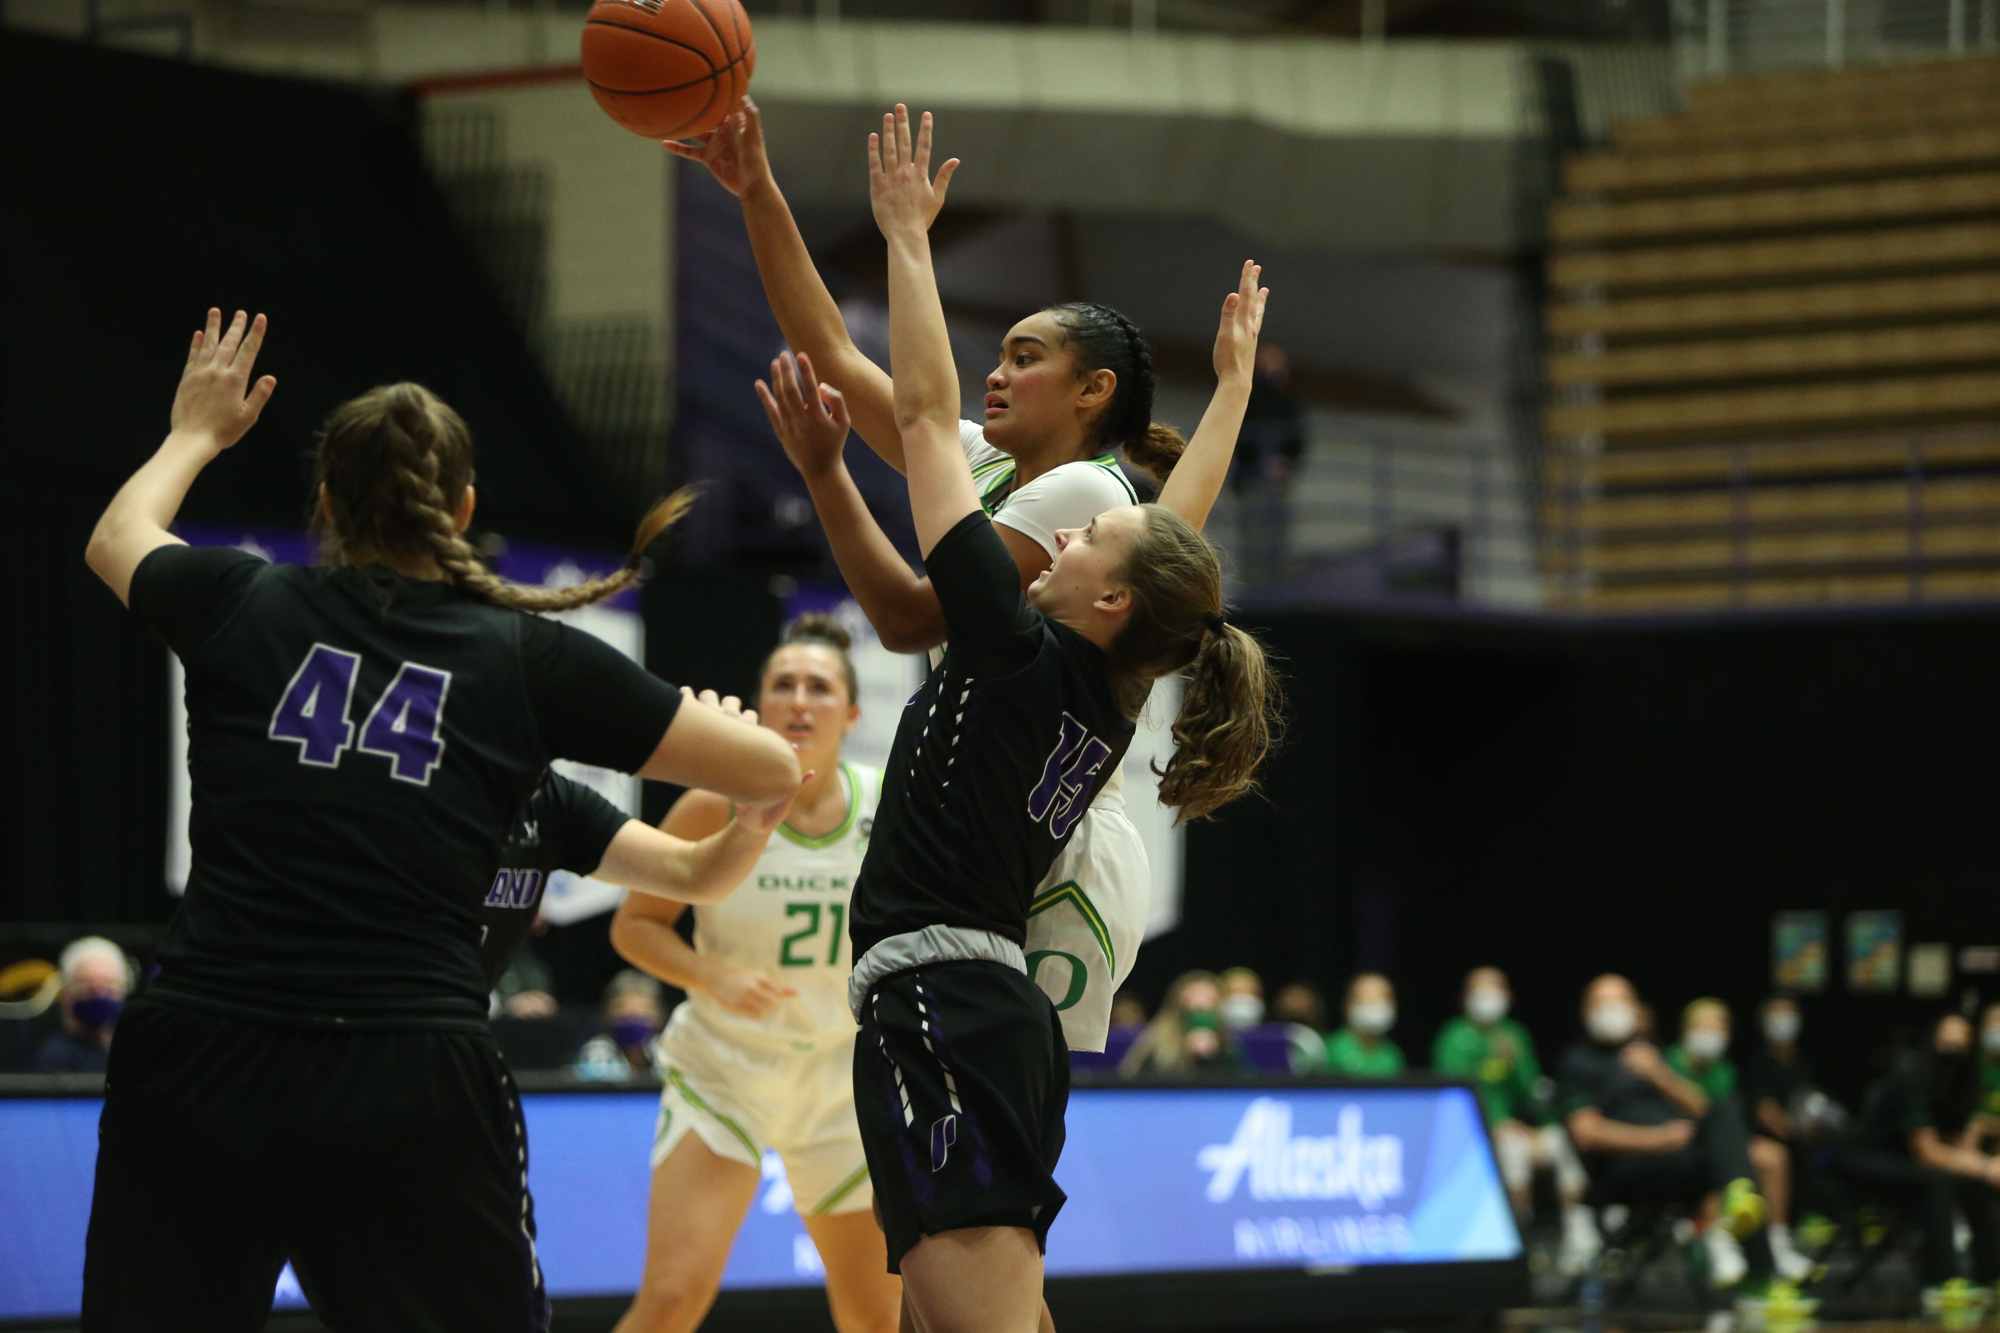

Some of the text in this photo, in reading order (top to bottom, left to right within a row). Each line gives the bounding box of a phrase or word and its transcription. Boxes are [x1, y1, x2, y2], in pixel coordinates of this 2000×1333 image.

[268, 642, 452, 787] 44
[1027, 711, 1112, 840] 15
[483, 867, 543, 910] AND
[758, 874, 858, 891] DUCK
[779, 903, 844, 966] 21
[1197, 1097, 1404, 1212] Alaska
